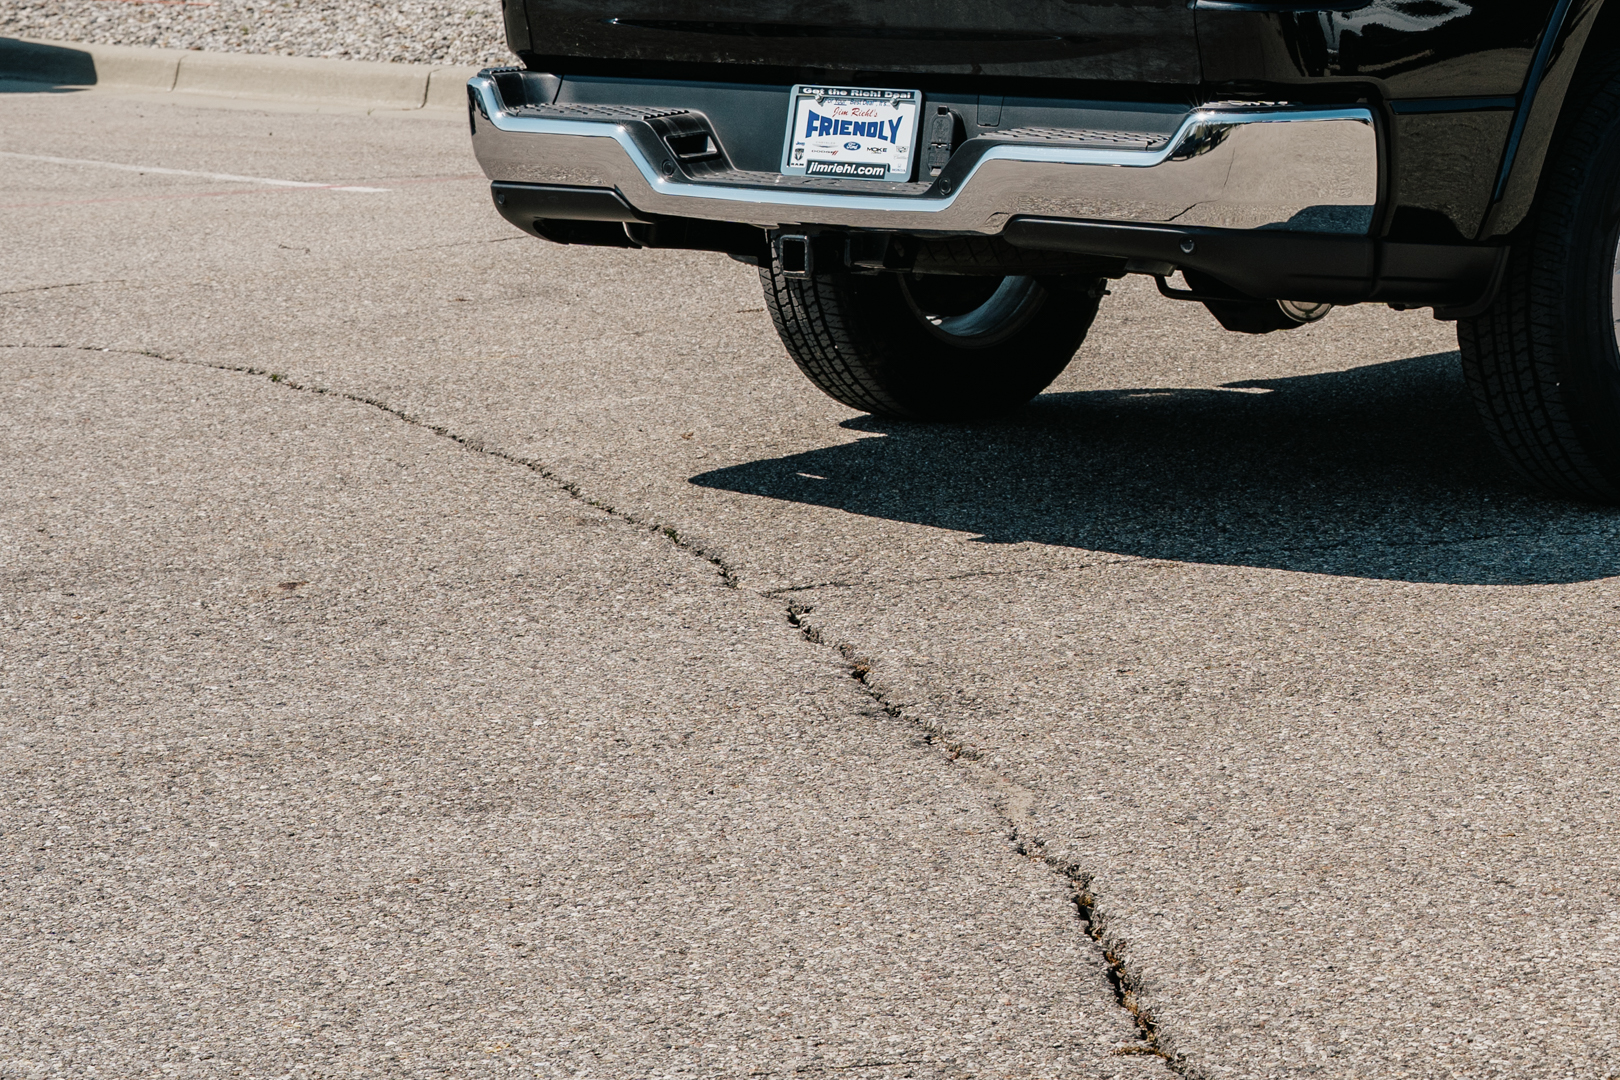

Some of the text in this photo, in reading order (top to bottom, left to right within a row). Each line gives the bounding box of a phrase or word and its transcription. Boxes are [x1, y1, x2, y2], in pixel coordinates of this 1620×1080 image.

[828, 88, 848, 96] the
[850, 89, 881, 98] Riehl
[832, 107, 878, 118] Jim Riehl's
[805, 109, 903, 144] FRIENDLY
[807, 162, 884, 176] jimriehl.com
